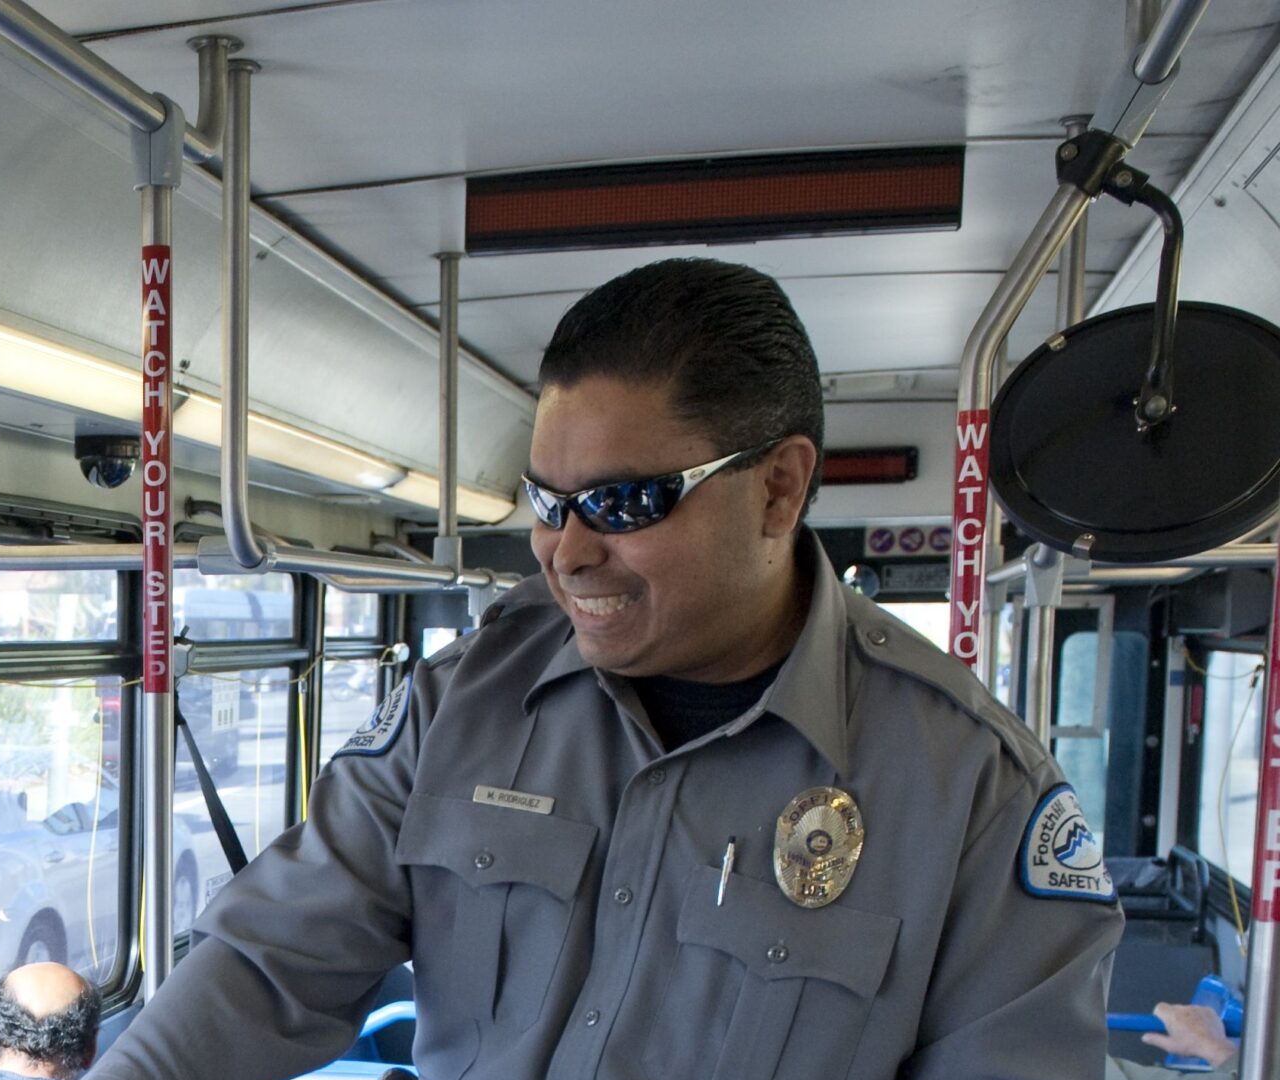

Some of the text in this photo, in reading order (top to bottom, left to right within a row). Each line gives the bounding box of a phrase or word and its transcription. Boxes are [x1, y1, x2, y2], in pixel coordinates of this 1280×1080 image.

[142, 258, 170, 677] WATCH YOUR STEP
[953, 423, 988, 674] WATCH YO
[1048, 872, 1100, 890] SAFETY
